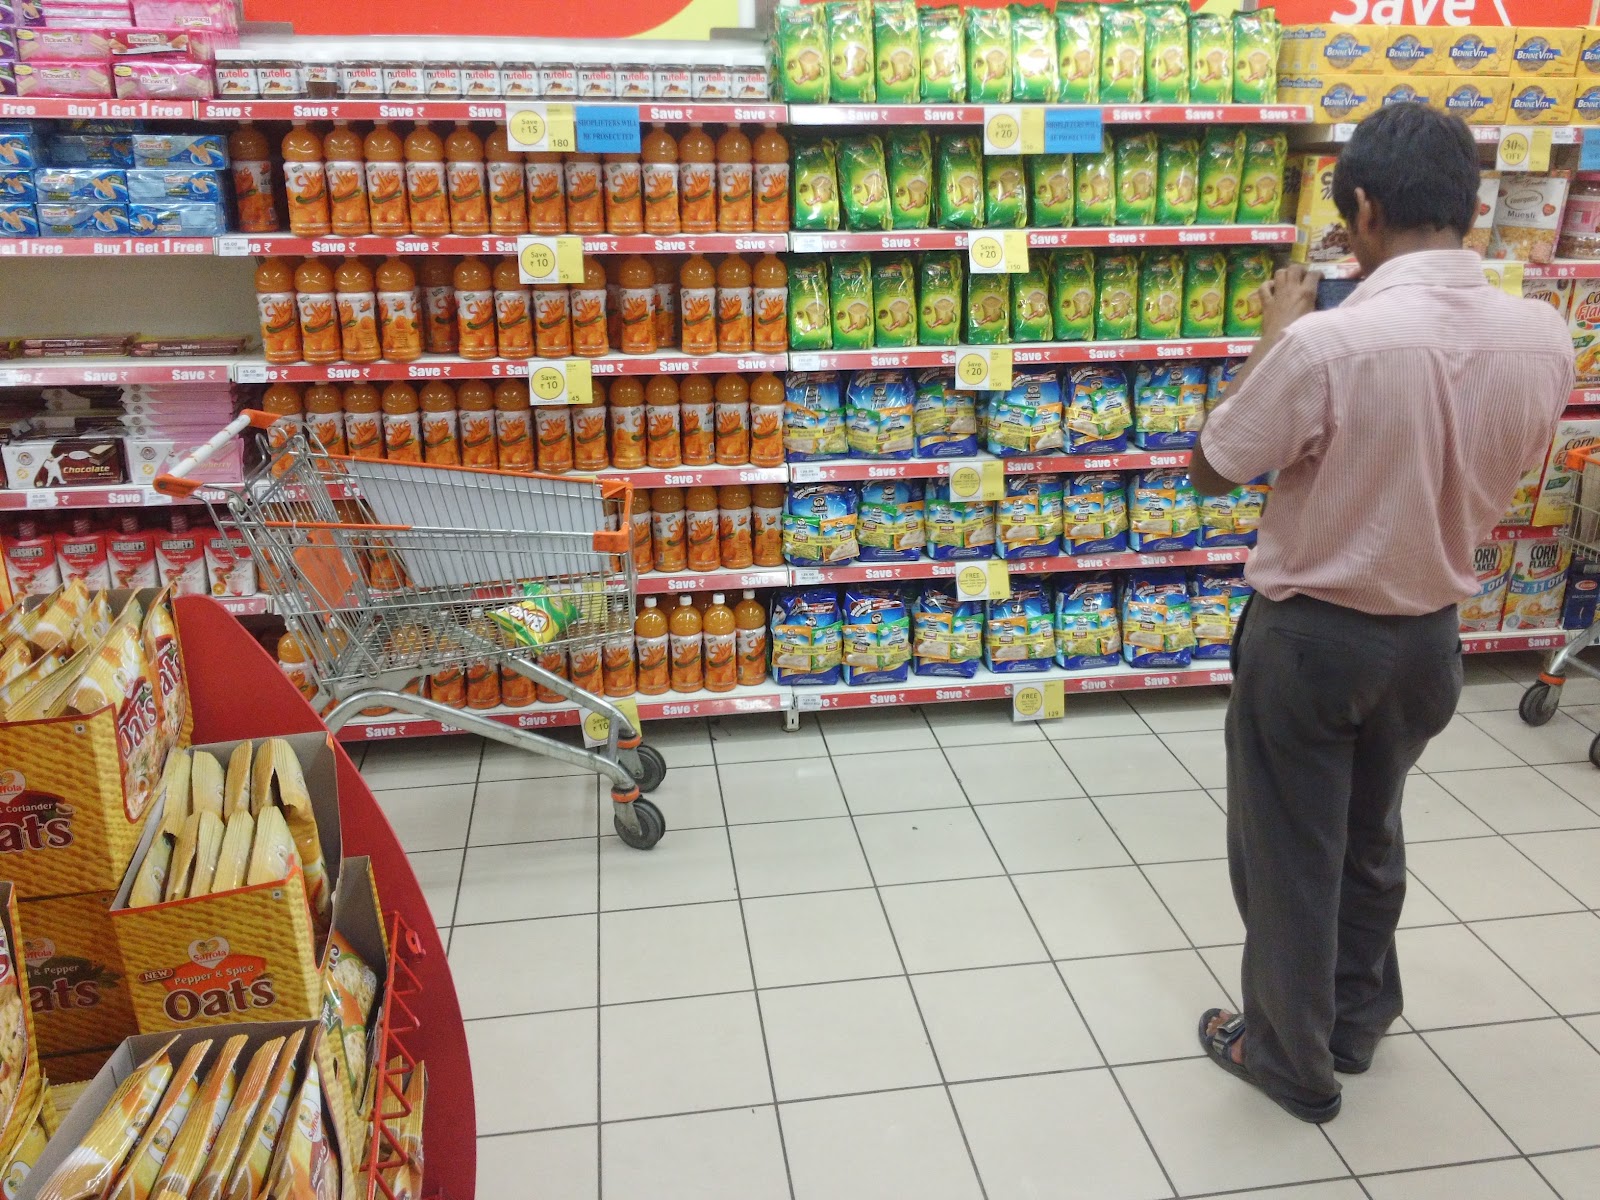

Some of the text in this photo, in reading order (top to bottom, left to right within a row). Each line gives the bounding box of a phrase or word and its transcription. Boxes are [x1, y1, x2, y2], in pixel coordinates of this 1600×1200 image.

[1330, 0, 1476, 26] Save
[218, 69, 249, 78] nutella
[260, 69, 291, 78] nutella
[347, 69, 376, 78] nutella
[387, 70, 417, 80] nutella
[427, 70, 456, 80] nutella
[465, 70, 495, 80] nutella
[503, 71, 533, 80] nutella
[544, 71, 573, 80] nutella
[582, 71, 612, 80] nutella
[620, 71, 650, 81] nutella
[660, 73, 689, 82] nutella
[698, 73, 726, 82] nutella
[737, 74, 765, 83] nutella
[2, 104, 35, 116] Free
[68, 103, 182, 118] Buy 1 Get 1 Free
[207, 106, 241, 117] Save
[293, 106, 328, 117] Save
[380, 106, 414, 117] Save
[469, 106, 502, 118] Save
[651, 108, 682, 120] Save
[735, 108, 766, 120] Save
[1113, 110, 1142, 120] Save
[1186, 110, 1214, 120] Save
[1260, 110, 1288, 120] Save
[848, 110, 878, 121] Save
[924, 110, 954, 121] Save
[1504, 140, 1524, 151] 30%
[1030, 234, 1058, 245] Save
[1108, 233, 1136, 243] Save
[1178, 232, 1206, 242] Save
[1251, 230, 1278, 241] Save
[0, 241, 63, 253] et 1 Free
[94, 240, 203, 255] Buy 1 Get 1 Free
[312, 242, 345, 252] Save
[396, 241, 429, 252] Save
[655, 240, 685, 250] Save
[735, 239, 765, 250] Save
[882, 238, 910, 248] Save
[1586, 291, 1600, 305] Co
[1089, 349, 1116, 359] Save
[1157, 346, 1184, 356] Save
[1227, 344, 1252, 354] Save
[871, 356, 899, 366] Save
[1014, 351, 1042, 361] Save
[660, 361, 689, 371] Save
[737, 359, 767, 370] Save
[83, 370, 117, 381] Save
[172, 370, 205, 380] Save
[327, 367, 360, 378] Save
[409, 366, 441, 377] Save
[1565, 438, 1594, 450] Corn
[1084, 458, 1111, 469] Save
[1150, 456, 1176, 466] Save
[63, 465, 110, 474] Chocolate
[1007, 461, 1034, 472] Save
[740, 471, 768, 481] Save
[868, 467, 897, 477] Save
[665, 474, 693, 484] Save
[108, 493, 141, 504] Save
[1208, 552, 1232, 562] Save
[1475, 548, 1497, 562] ORN
[1531, 545, 1558, 560] CORN
[1077, 558, 1103, 568] Save
[1141, 555, 1166, 565] Save
[1529, 560, 1555, 569] FLAKES
[866, 569, 892, 578] Save
[668, 579, 696, 590] Save
[742, 575, 768, 586] Save
[1528, 638, 1550, 647] Save
[1144, 676, 1169, 686] Save
[1210, 672, 1233, 682] Save
[1081, 680, 1106, 690] Save
[870, 694, 897, 704] Save
[936, 690, 962, 699] Save
[663, 704, 690, 715] Save
[518, 715, 547, 727] Save
[366, 726, 396, 737] Save
[6, 803, 52, 813] Coriander
[0, 815, 72, 851] ats
[26, 949, 52, 962] affola
[192, 951, 227, 963] Saffola
[45, 964, 79, 979] Pepper
[143, 969, 168, 980] NEW
[174, 964, 254, 986] Pepper & Spice
[30, 980, 99, 1012] ats
[164, 979, 276, 1022] Oats
